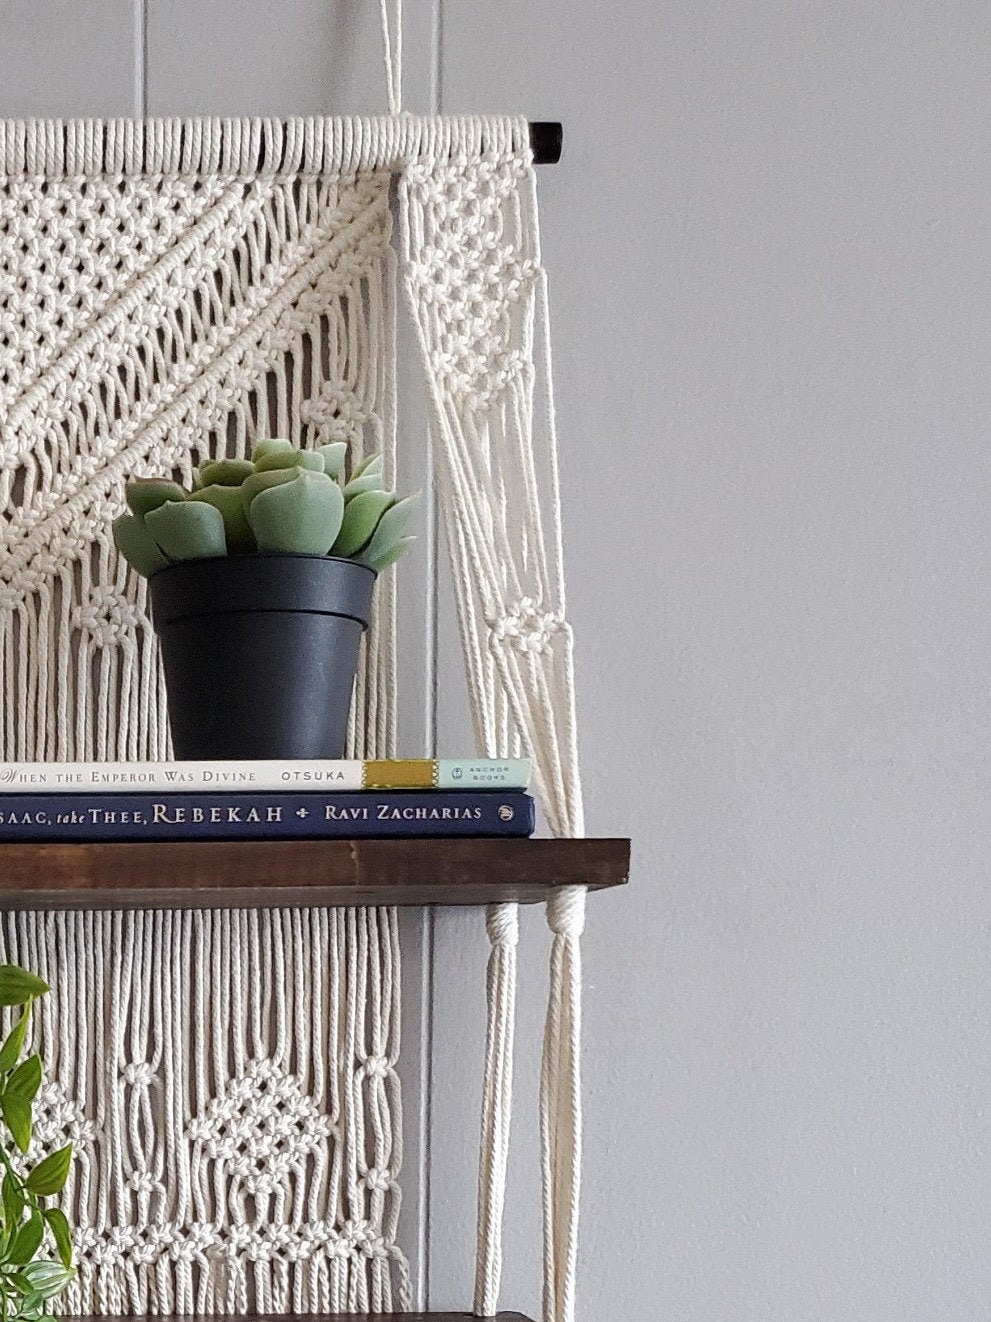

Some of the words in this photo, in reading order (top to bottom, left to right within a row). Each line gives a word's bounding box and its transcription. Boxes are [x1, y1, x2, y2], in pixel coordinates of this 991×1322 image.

[56, 773, 83, 783] THE
[91, 771, 156, 783] EMPEROR
[164, 771, 194, 783] WAS
[202, 771, 256, 783] DIVINE
[281, 771, 345, 781] OTSUKA
[56, 812, 86, 825] take
[87, 807, 148, 826] THEE,
[152, 804, 282, 824] REBEKAH
[325, 804, 368, 820] RAVI
[377, 804, 482, 820] ZACHARIAS
